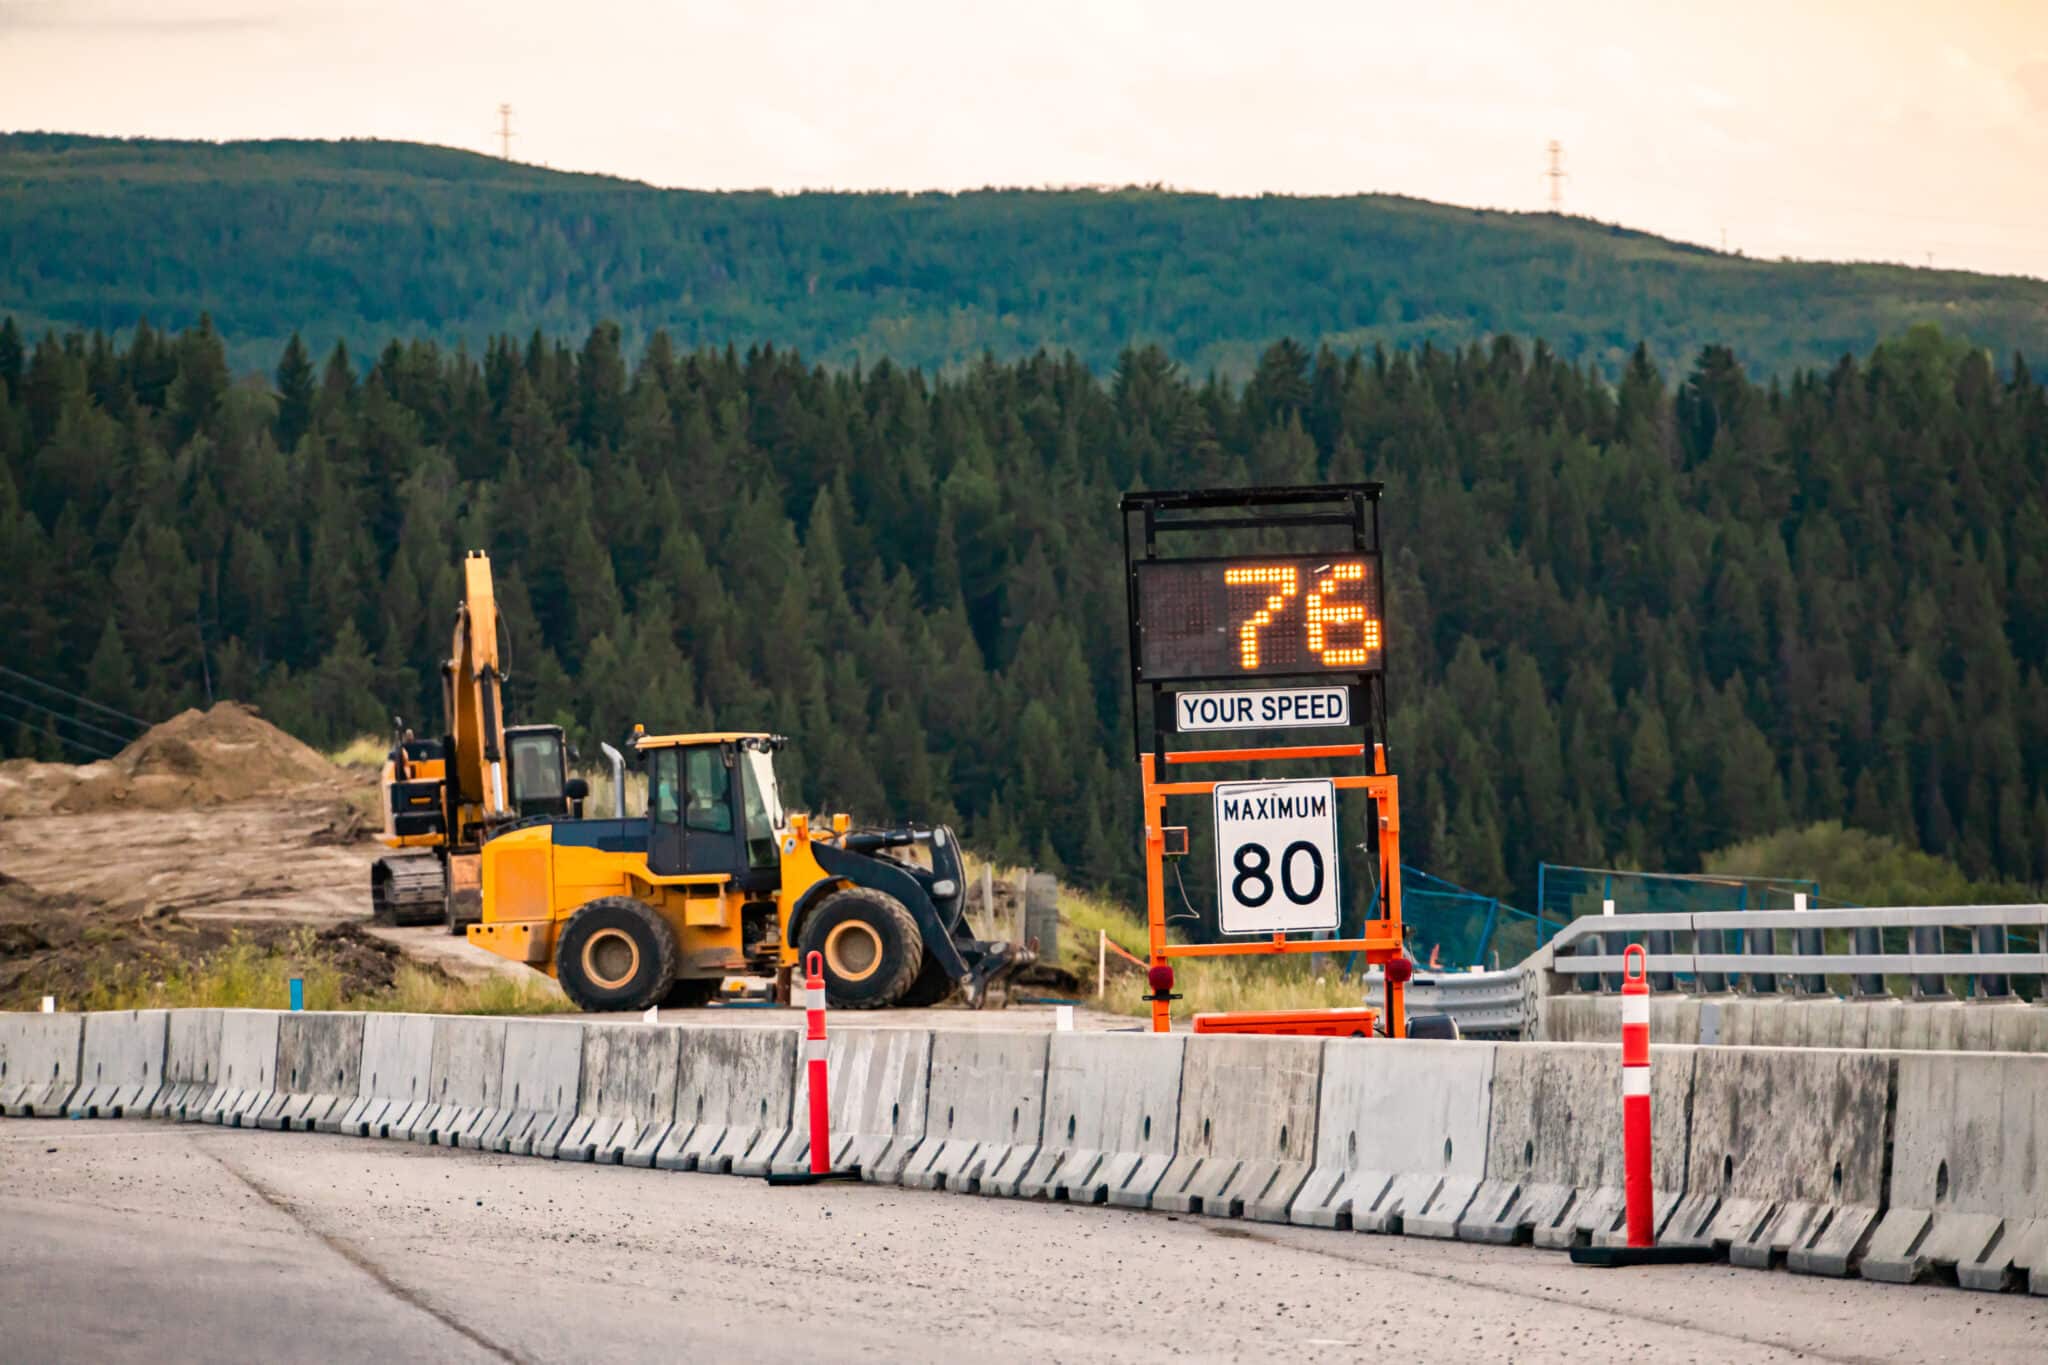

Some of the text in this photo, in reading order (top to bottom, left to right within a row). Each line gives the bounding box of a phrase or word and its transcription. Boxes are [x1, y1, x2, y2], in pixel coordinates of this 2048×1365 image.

[1224, 563, 1381, 670] 76
[1183, 694, 1343, 723] YOUR SPEED
[1223, 796, 1327, 821] MAXIMUM
[1232, 840, 1325, 908] 80
